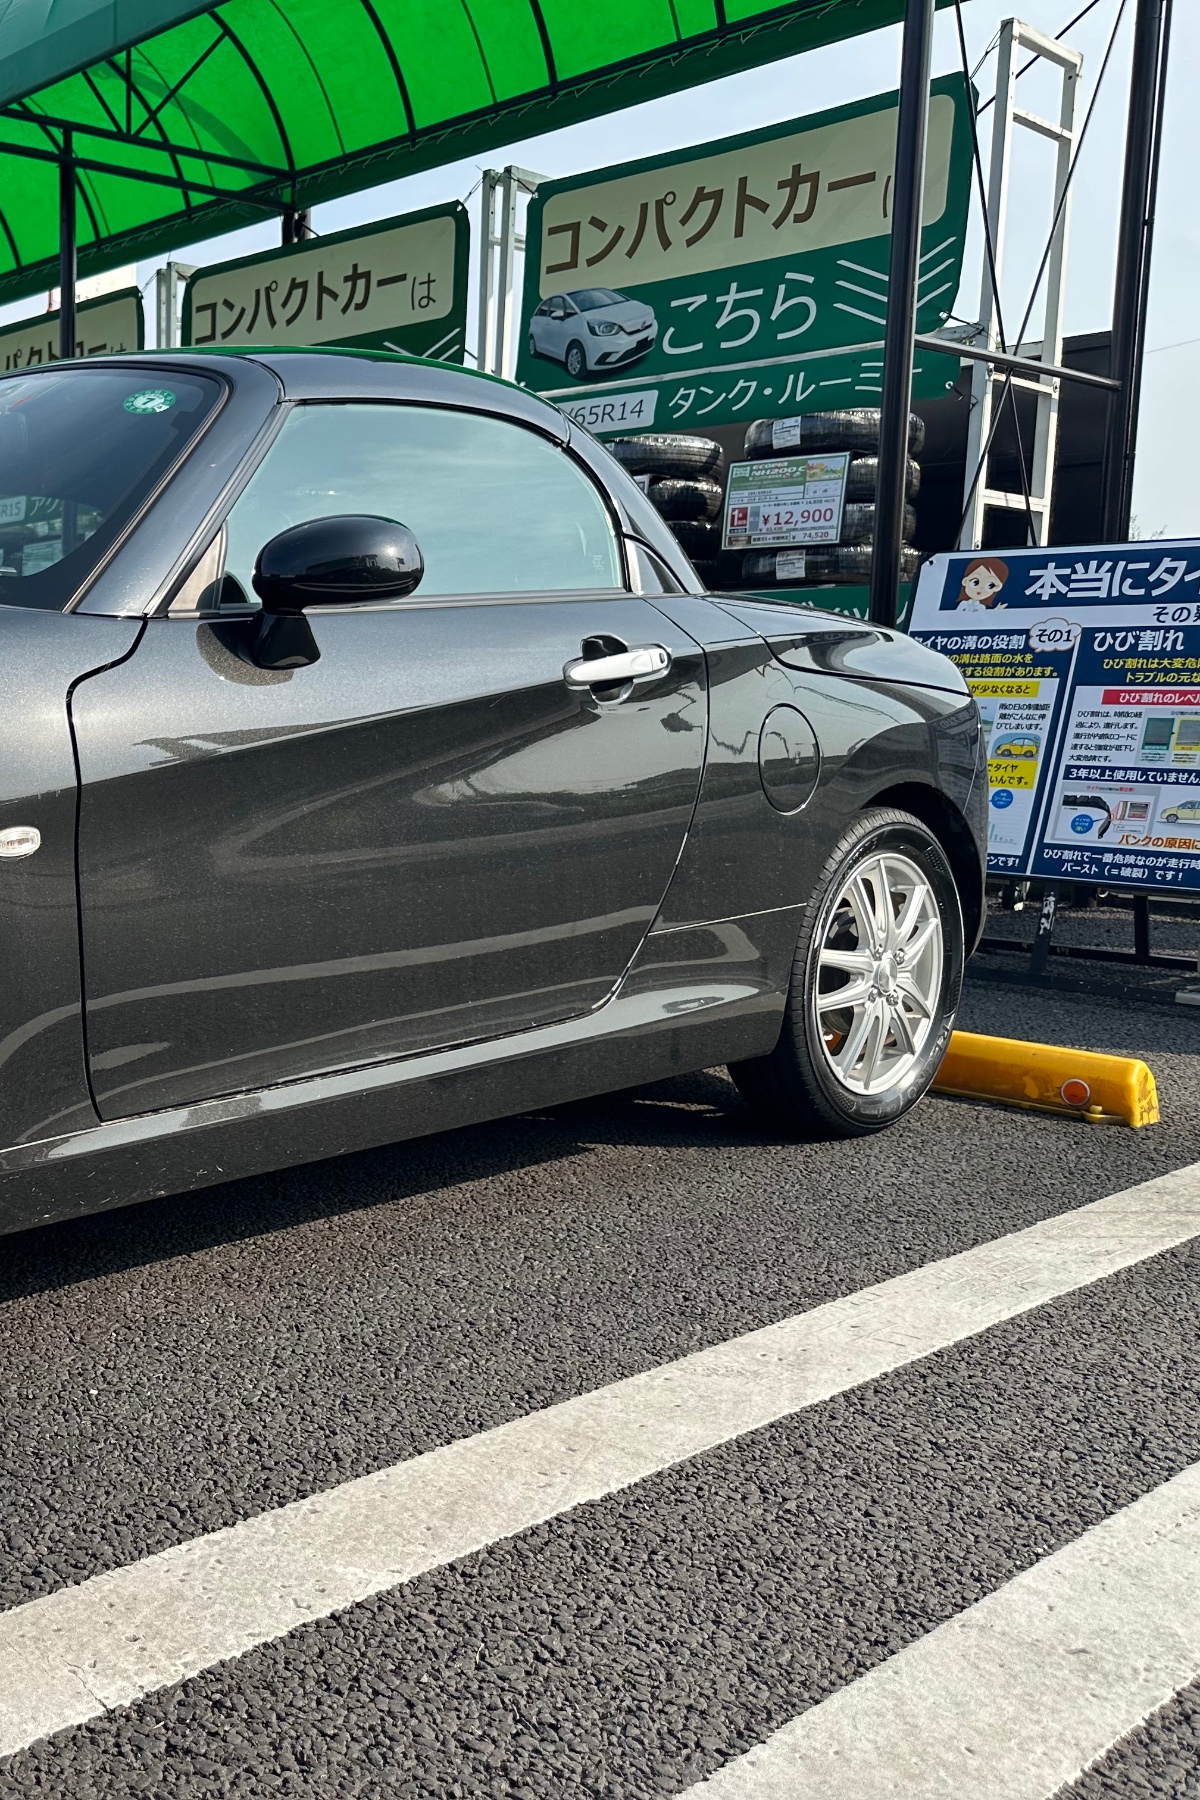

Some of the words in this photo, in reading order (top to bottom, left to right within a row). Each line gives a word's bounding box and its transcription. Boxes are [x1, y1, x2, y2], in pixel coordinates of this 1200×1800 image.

[194, 263, 436, 345] コンパクトカーは
[662, 271, 817, 355] こちら
[669, 362, 922, 419] タンク・ルーミ
[1035, 628, 1073, 643] その1
[1093, 629, 1185, 652] ひび割れ
[946, 653, 1034, 664] の溝は路面の水を
[969, 684, 1031, 695] が少なくなると
[1069, 768, 1200, 784] 3年以上使用していません
